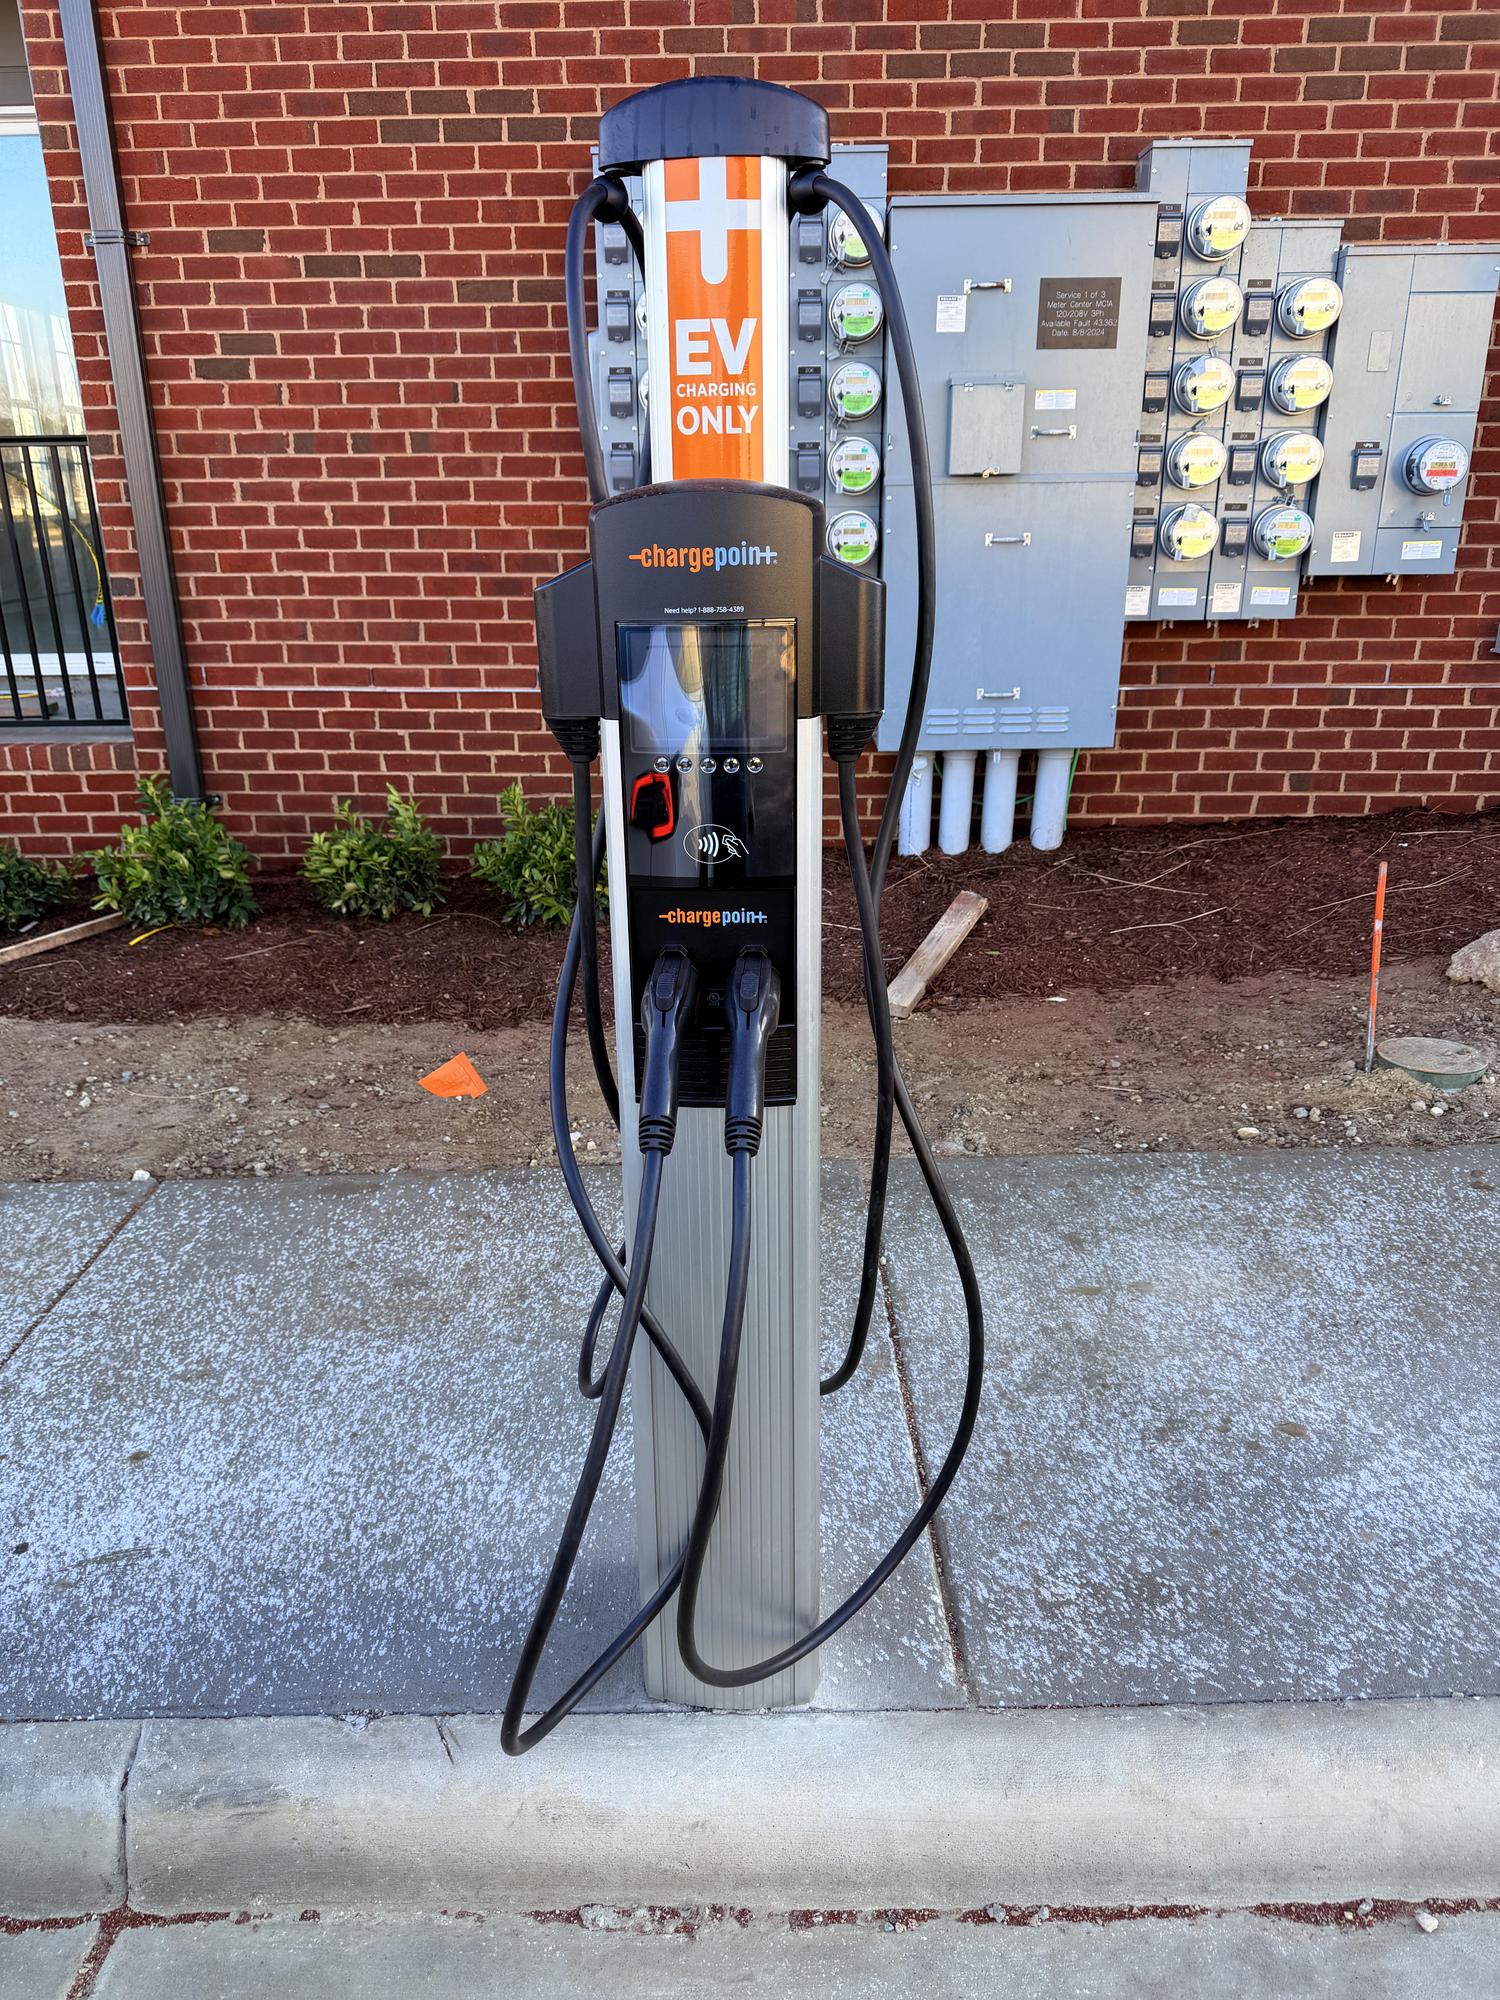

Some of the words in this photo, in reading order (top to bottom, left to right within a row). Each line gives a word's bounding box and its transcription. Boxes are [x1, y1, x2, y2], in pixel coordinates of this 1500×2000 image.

[1056, 290, 1082, 300] Service
[1090, 290, 1098, 298] of
[1101, 290, 1106, 298] 3
[1047, 301, 1067, 309] Meter
[1070, 300, 1092, 308] Center
[1056, 310, 1088, 318] 120/208V
[1090, 309, 1104, 317] 3Ph
[1073, 319, 1091, 327] Fault
[1072, 328, 1105, 336] 8/8/2024
[675, 318, 757, 376] EV
[676, 382, 757, 398] CHARGING
[676, 405, 759, 435] ONLY
[680, 606, 697, 615] help?
[698, 605, 745, 614] 1-888-758-4389
[658, 907, 768, 927] chargepoint
